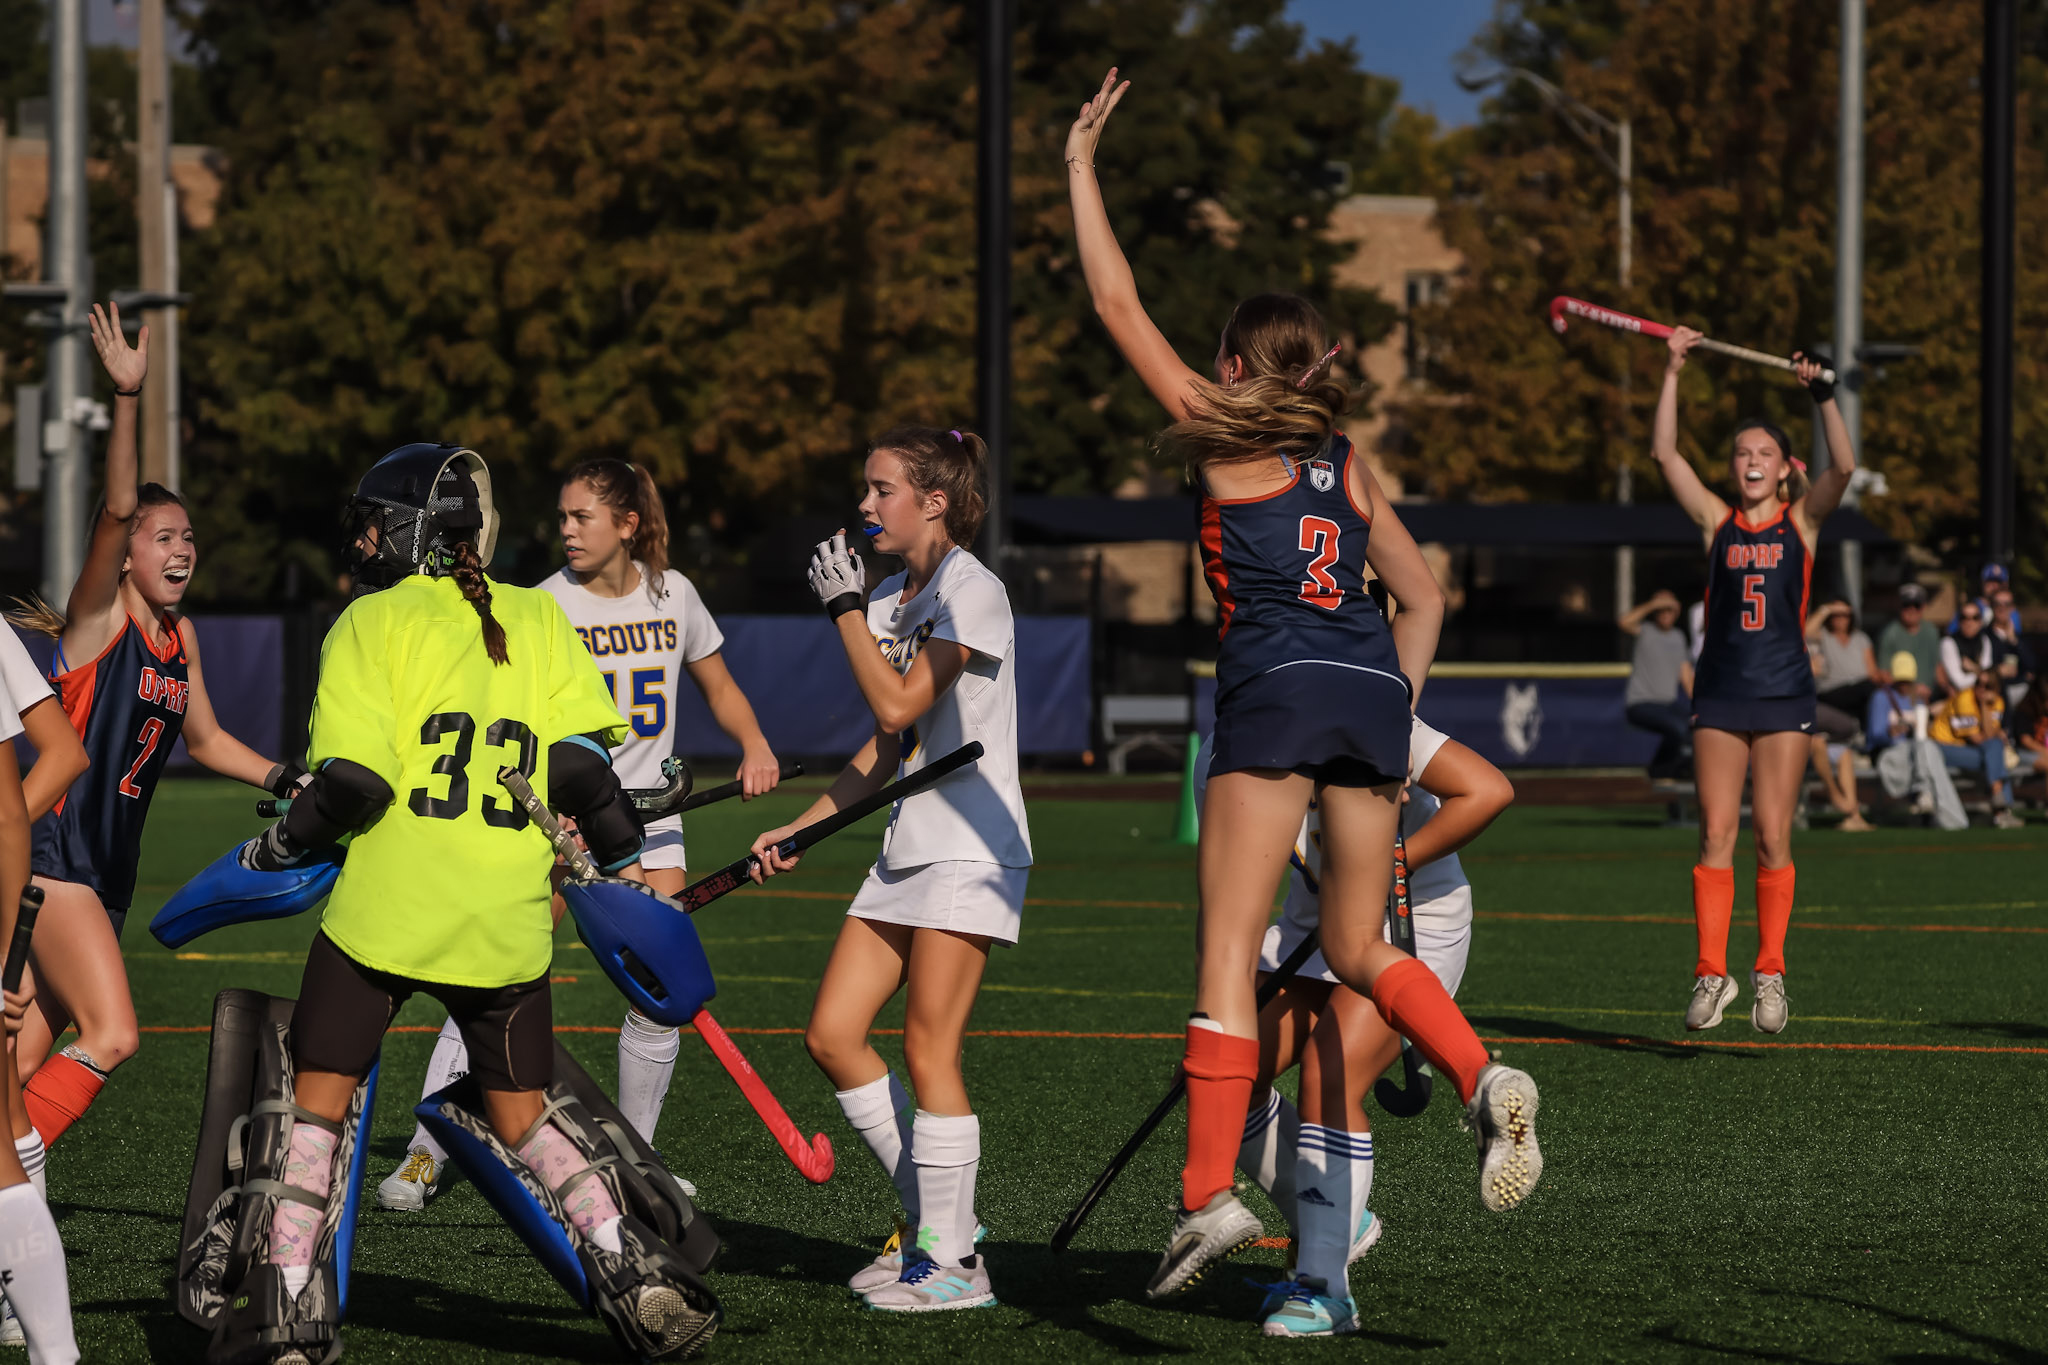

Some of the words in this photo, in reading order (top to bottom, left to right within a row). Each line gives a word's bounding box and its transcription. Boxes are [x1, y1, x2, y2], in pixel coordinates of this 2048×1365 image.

[1726, 543, 1784, 569] OPRF
[1741, 574, 1767, 632] 5
[118, 717, 166, 799] 2
[407, 711, 539, 832] 33
